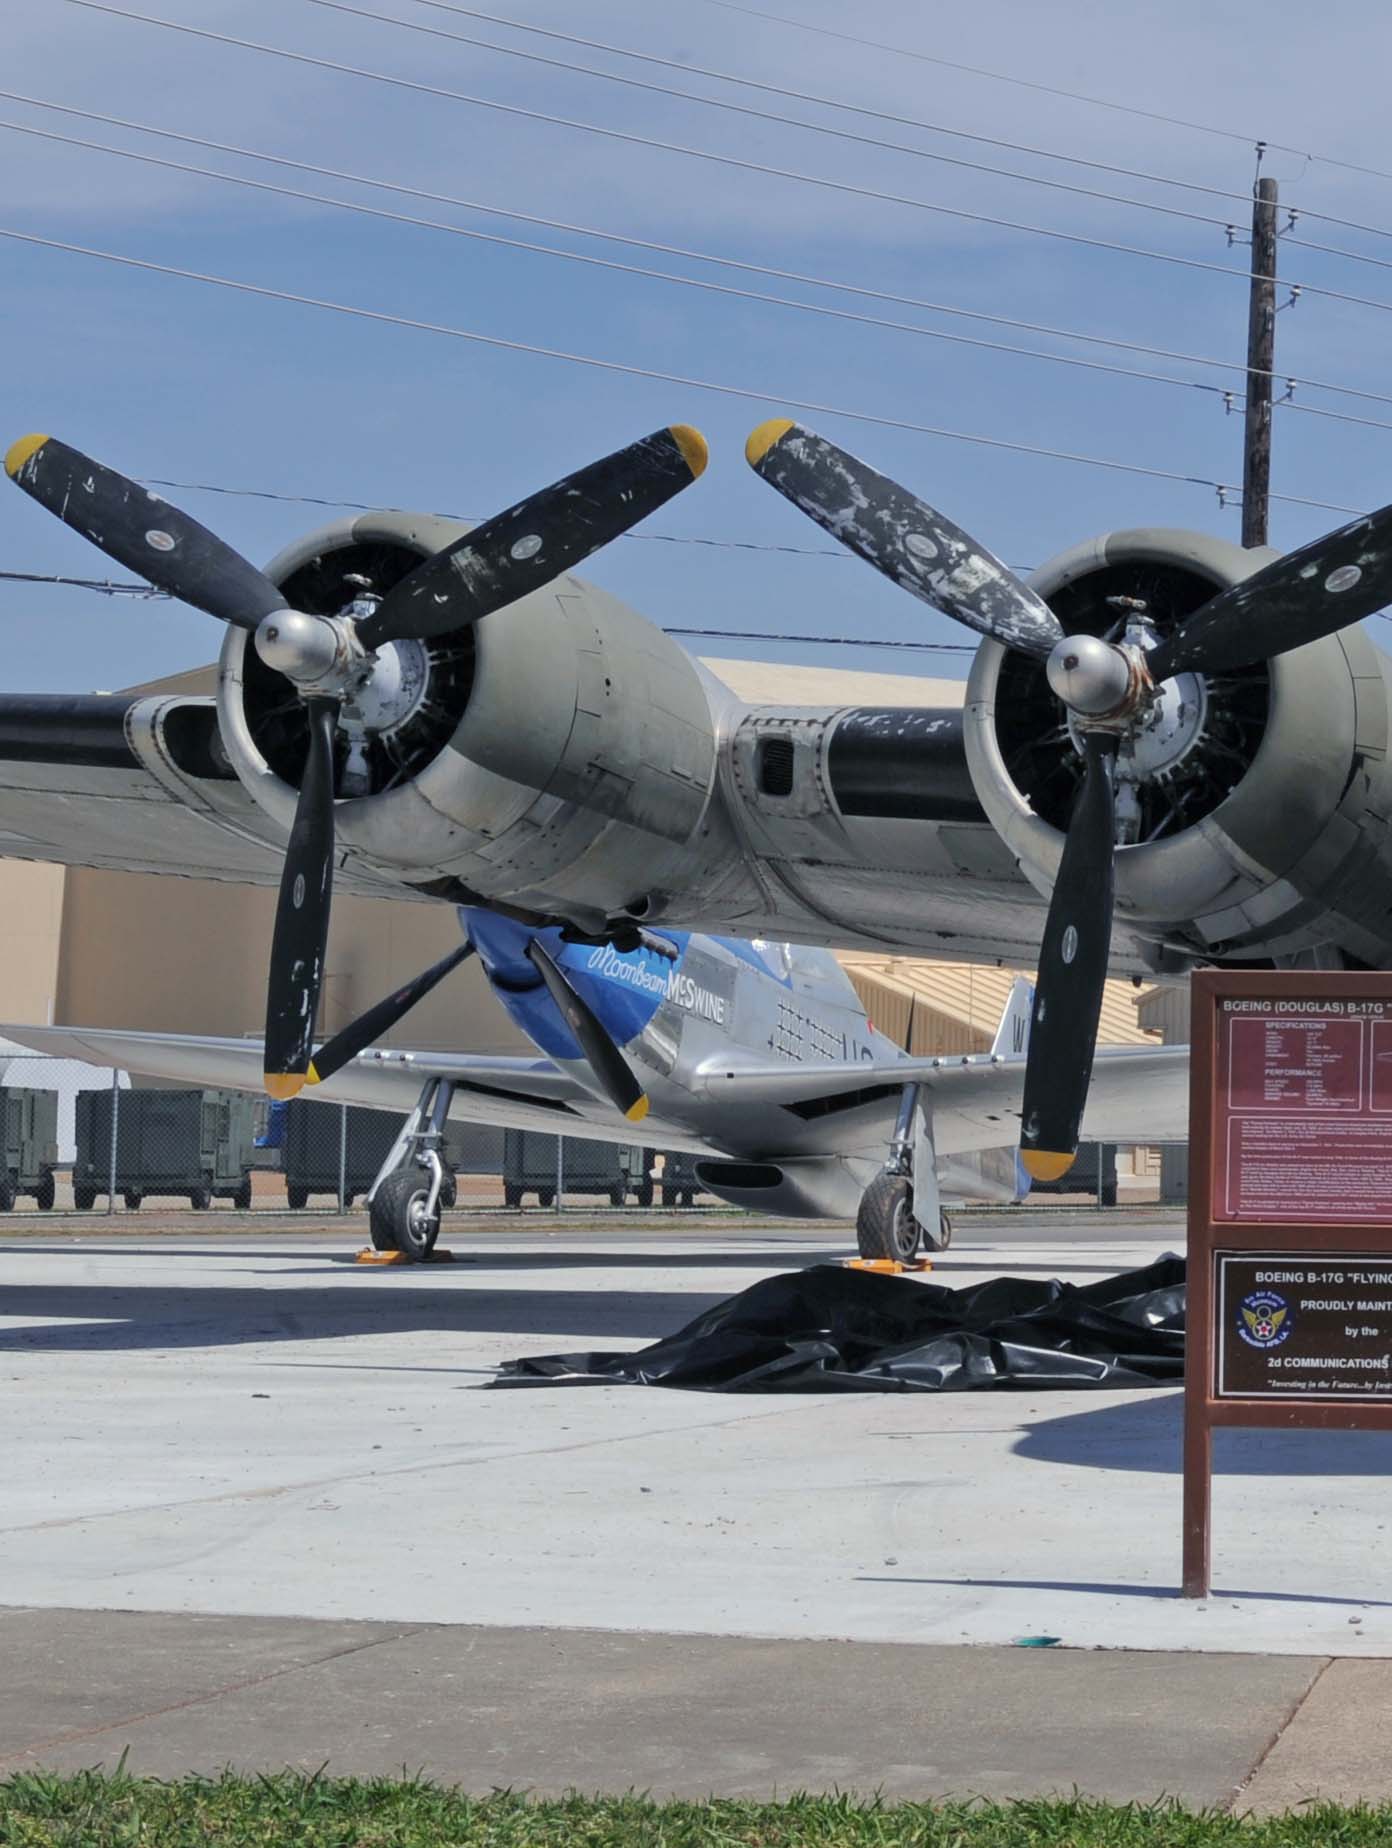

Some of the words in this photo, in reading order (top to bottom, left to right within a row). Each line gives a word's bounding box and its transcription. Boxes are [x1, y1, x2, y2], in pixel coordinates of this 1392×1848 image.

[588, 941, 668, 996] Moonbeam
[1223, 1000, 1272, 1012] BOEING
[1275, 1001, 1344, 1014] (DOUGLAS)
[1347, 1002, 1384, 1014] B-17G
[1264, 1021, 1327, 1030] SPECIFICATIONS
[1013, 1014, 1026, 1053] W
[1264, 1068, 1322, 1077] PERFORMANCE
[1255, 1271, 1304, 1283] BOEING
[1307, 1272, 1344, 1284] B-17G
[1300, 1300, 1354, 1311] PROUDLY
[1345, 1326, 1359, 1338] by
[1361, 1326, 1378, 1336] the
[1267, 1357, 1282, 1368] 2d
[1283, 1358, 1389, 1369] COMMUNICATIONS
[1317, 1380, 1330, 1389] the
